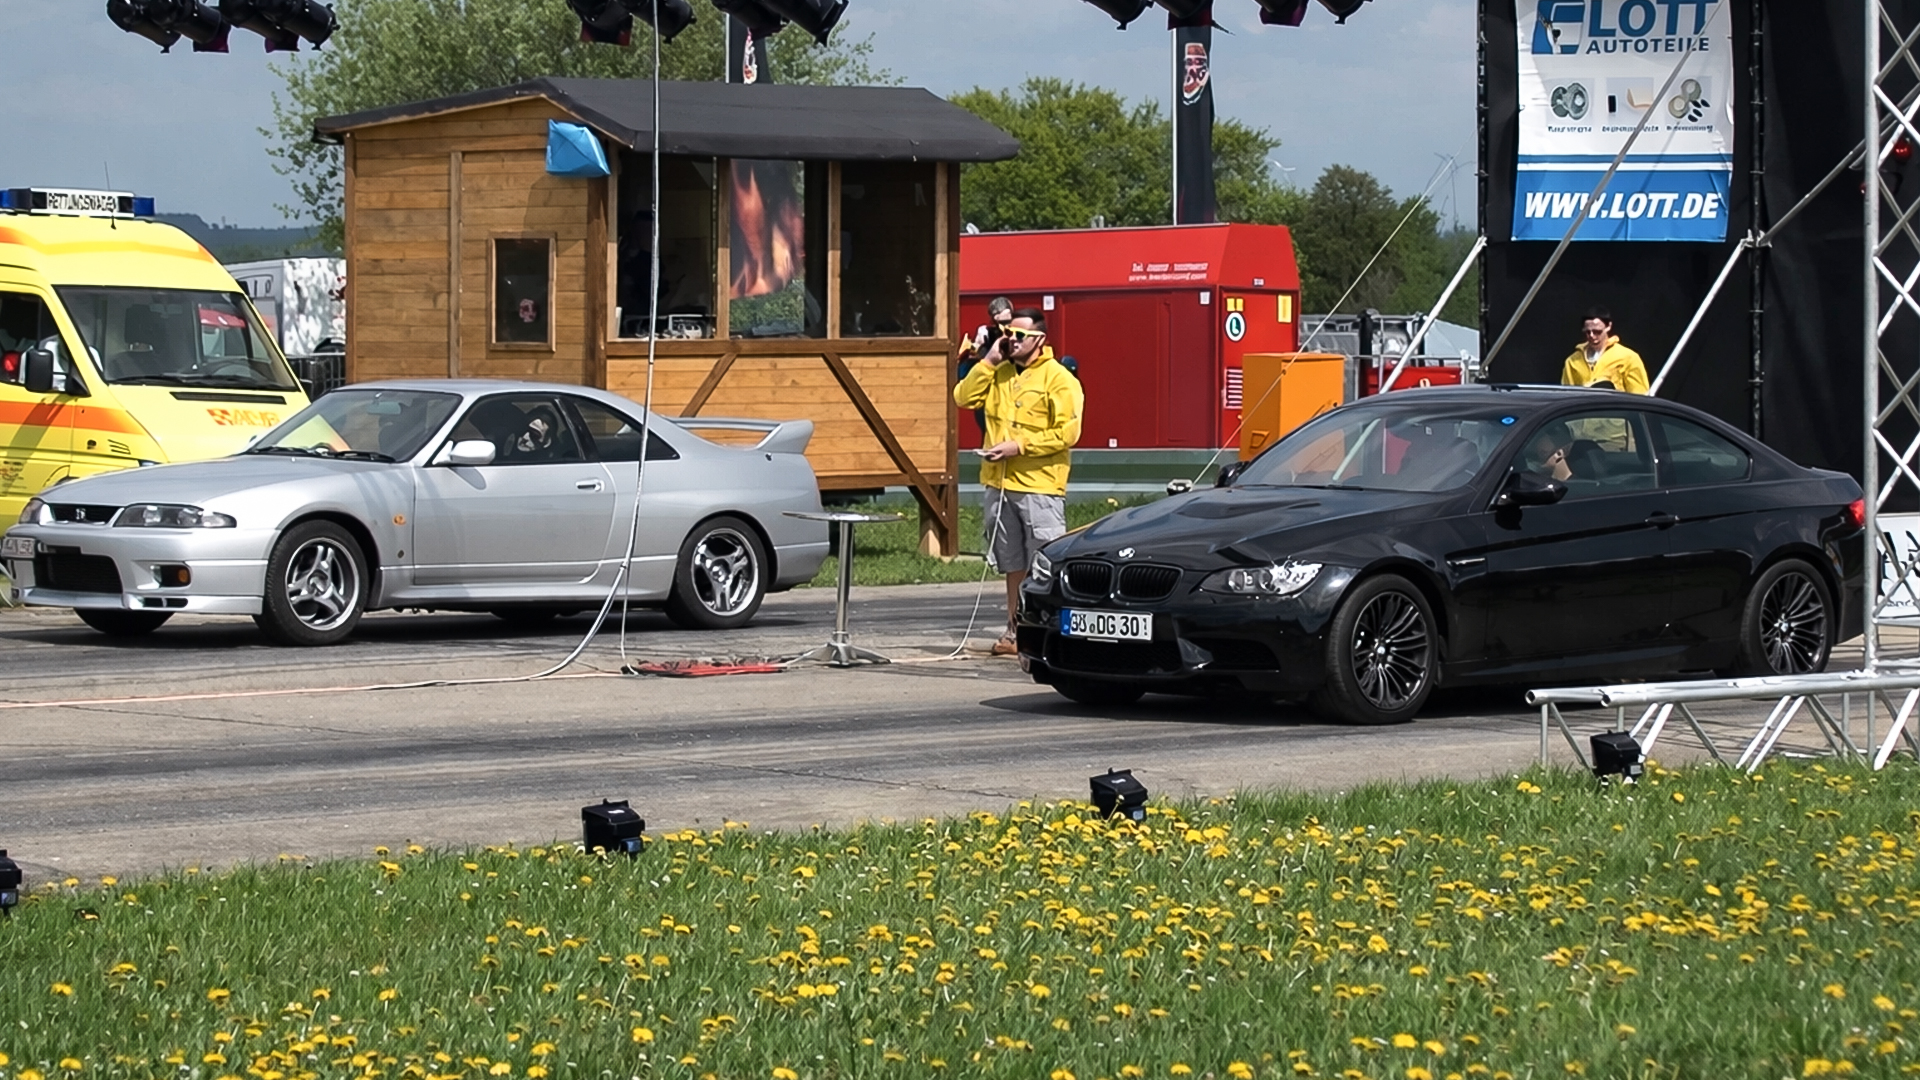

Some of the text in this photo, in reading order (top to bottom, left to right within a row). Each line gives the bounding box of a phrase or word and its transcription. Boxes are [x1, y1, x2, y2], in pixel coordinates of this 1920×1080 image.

[1588, 0, 1718, 37] LOTT
[1586, 38, 1709, 54] AUTOTEILE
[1525, 192, 1720, 219] WWW.LOTT.DE
